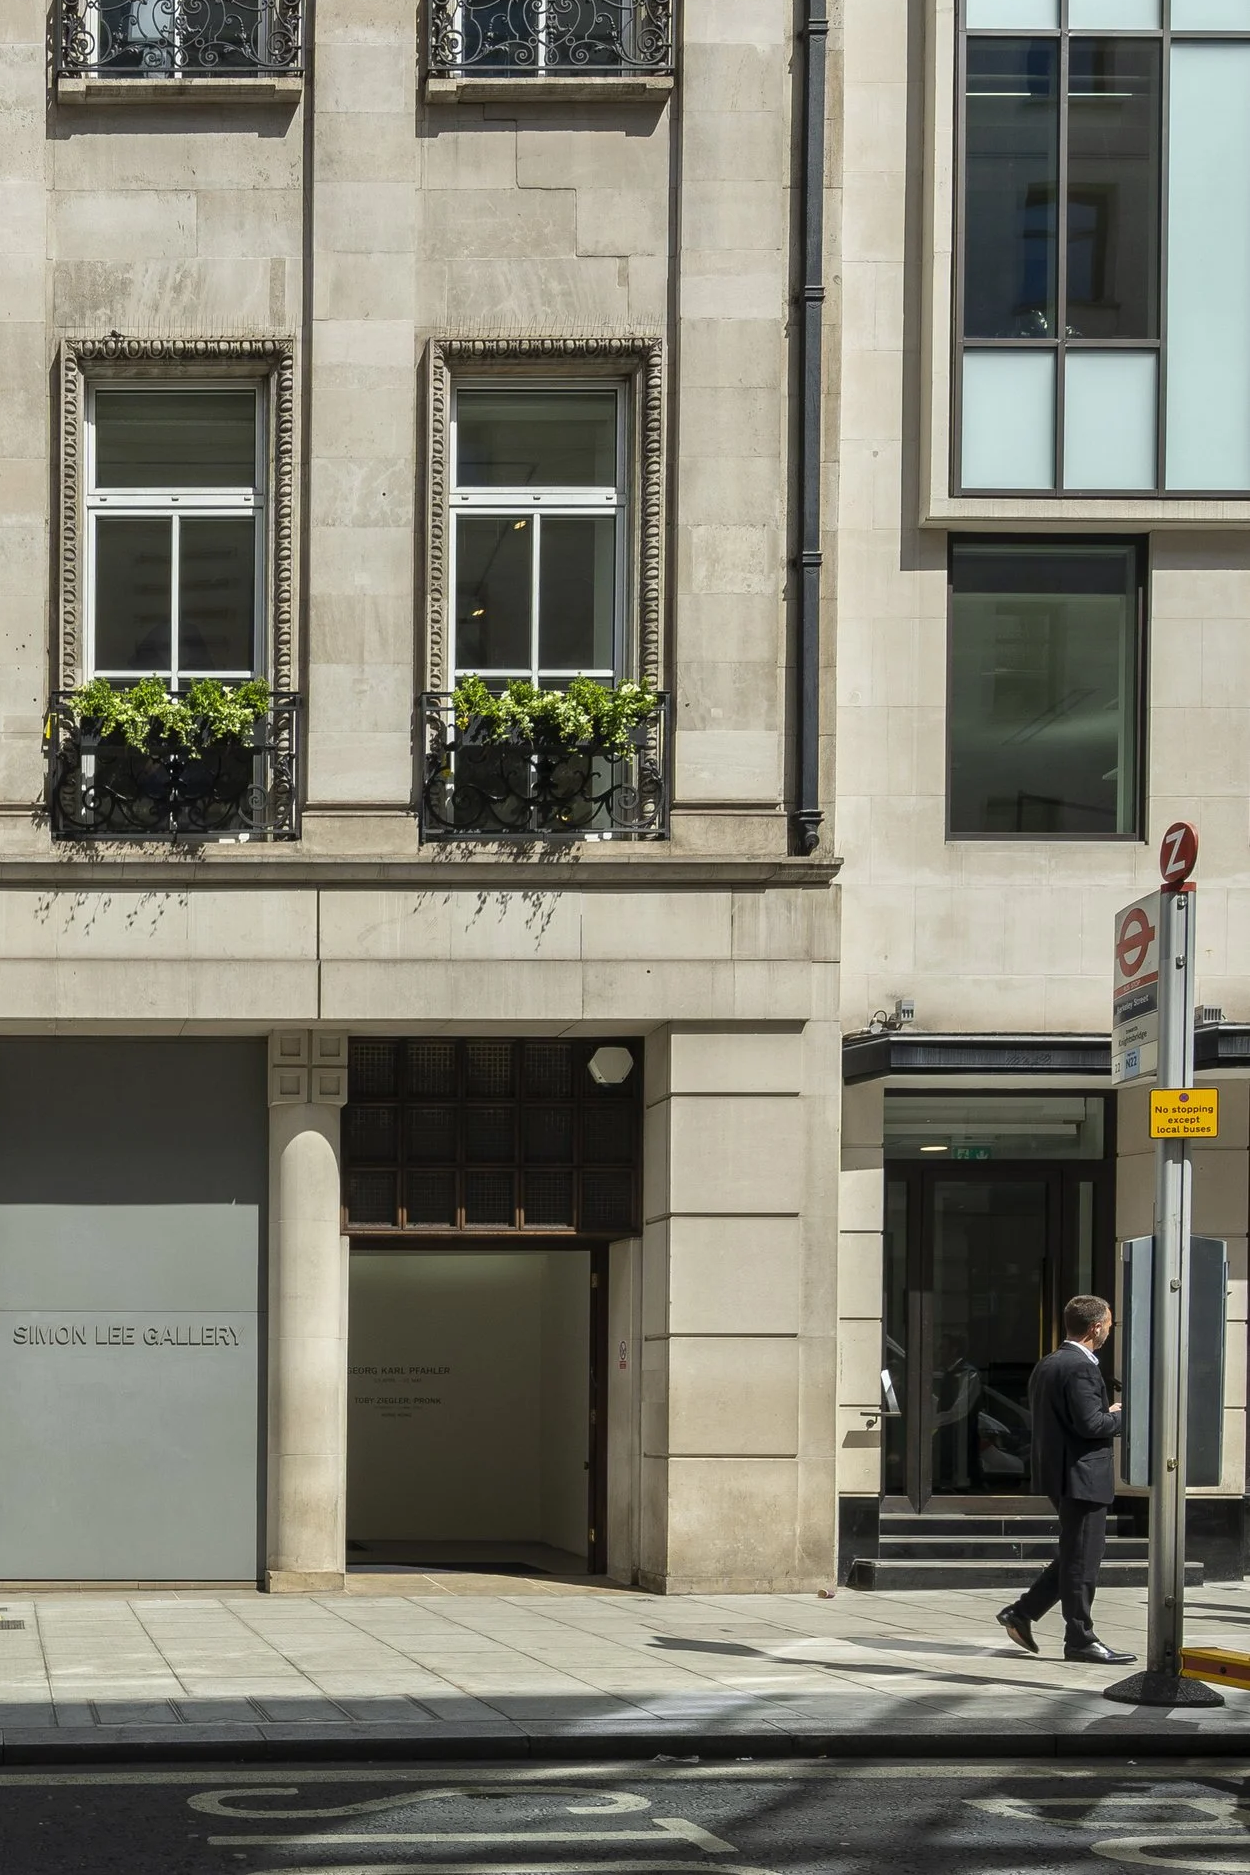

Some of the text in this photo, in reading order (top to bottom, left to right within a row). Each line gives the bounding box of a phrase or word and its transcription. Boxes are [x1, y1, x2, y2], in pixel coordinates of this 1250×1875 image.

[1165, 828, 1186, 876] Z
[1133, 994, 1149, 1007] Street
[1115, 1056, 1137, 1074] 22 N22
[1155, 1105, 1214, 1114] No stopping
[1168, 1116, 1200, 1125] except
[1157, 1125, 1211, 1134] local buses
[13, 1325, 246, 1346] SIMON LEE GALLERY
[347, 1366, 451, 1375] GEORG KARL PFAHLER
[354, 1397, 374, 1405] TOBY
[413, 1397, 442, 1405] PRONK
